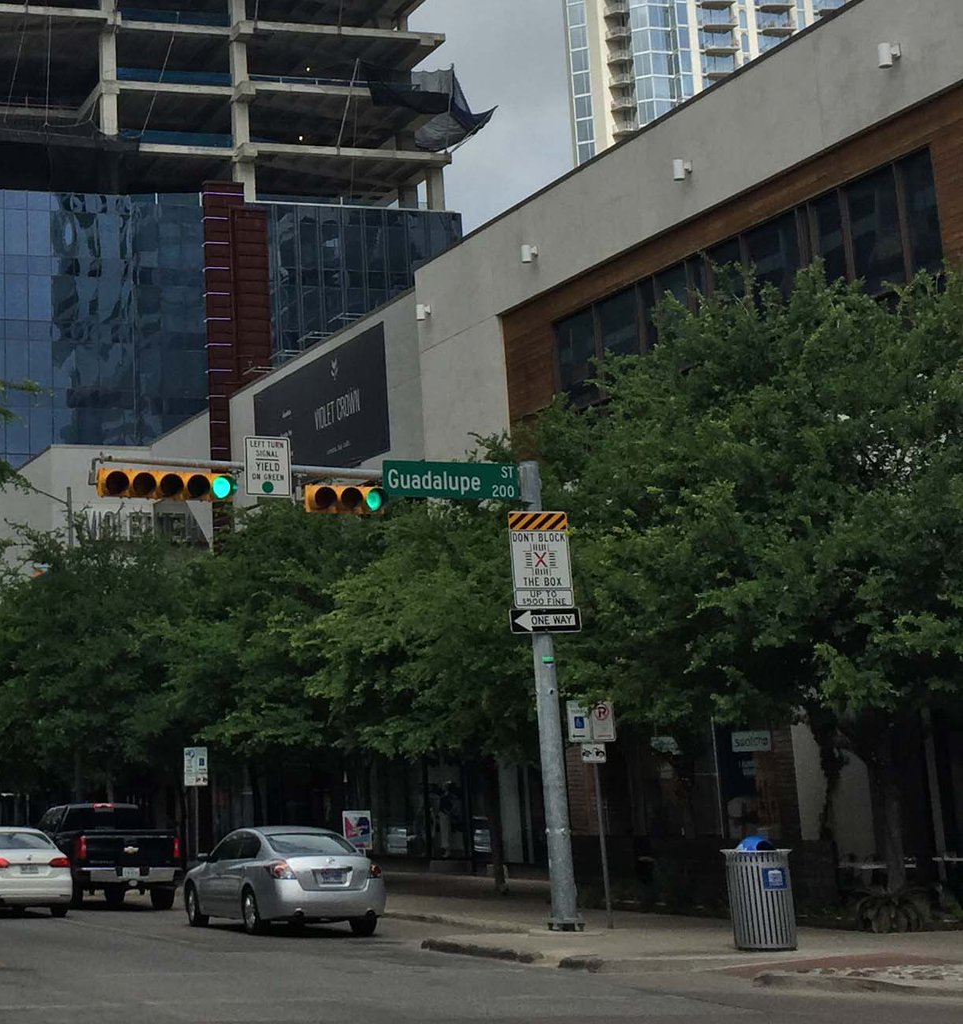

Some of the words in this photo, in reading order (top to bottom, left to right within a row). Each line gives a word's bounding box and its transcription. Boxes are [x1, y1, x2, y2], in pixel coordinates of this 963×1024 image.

[314, 401, 335, 431] VIOLET
[336, 388, 361, 421] CROWN
[249, 440, 265, 448] LEFT
[267, 441, 284, 449] TURN
[255, 450, 279, 458] SIGNAL
[255, 462, 280, 472] YIELD
[264, 473, 285, 481] GREEN
[388, 469, 481, 495] Guadalupe
[501, 466, 514, 479] ST
[492, 485, 515, 498] 200
[538, 533, 566, 543] BLOCK
[523, 577, 540, 587] THE
[544, 577, 563, 587] BOX
[530, 590, 542, 598] UP
[546, 590, 558, 598] TO
[522, 598, 545, 606] $500
[547, 598, 567, 606] FINE
[531, 616, 550, 626] ONE
[553, 615, 572, 625] WAY
